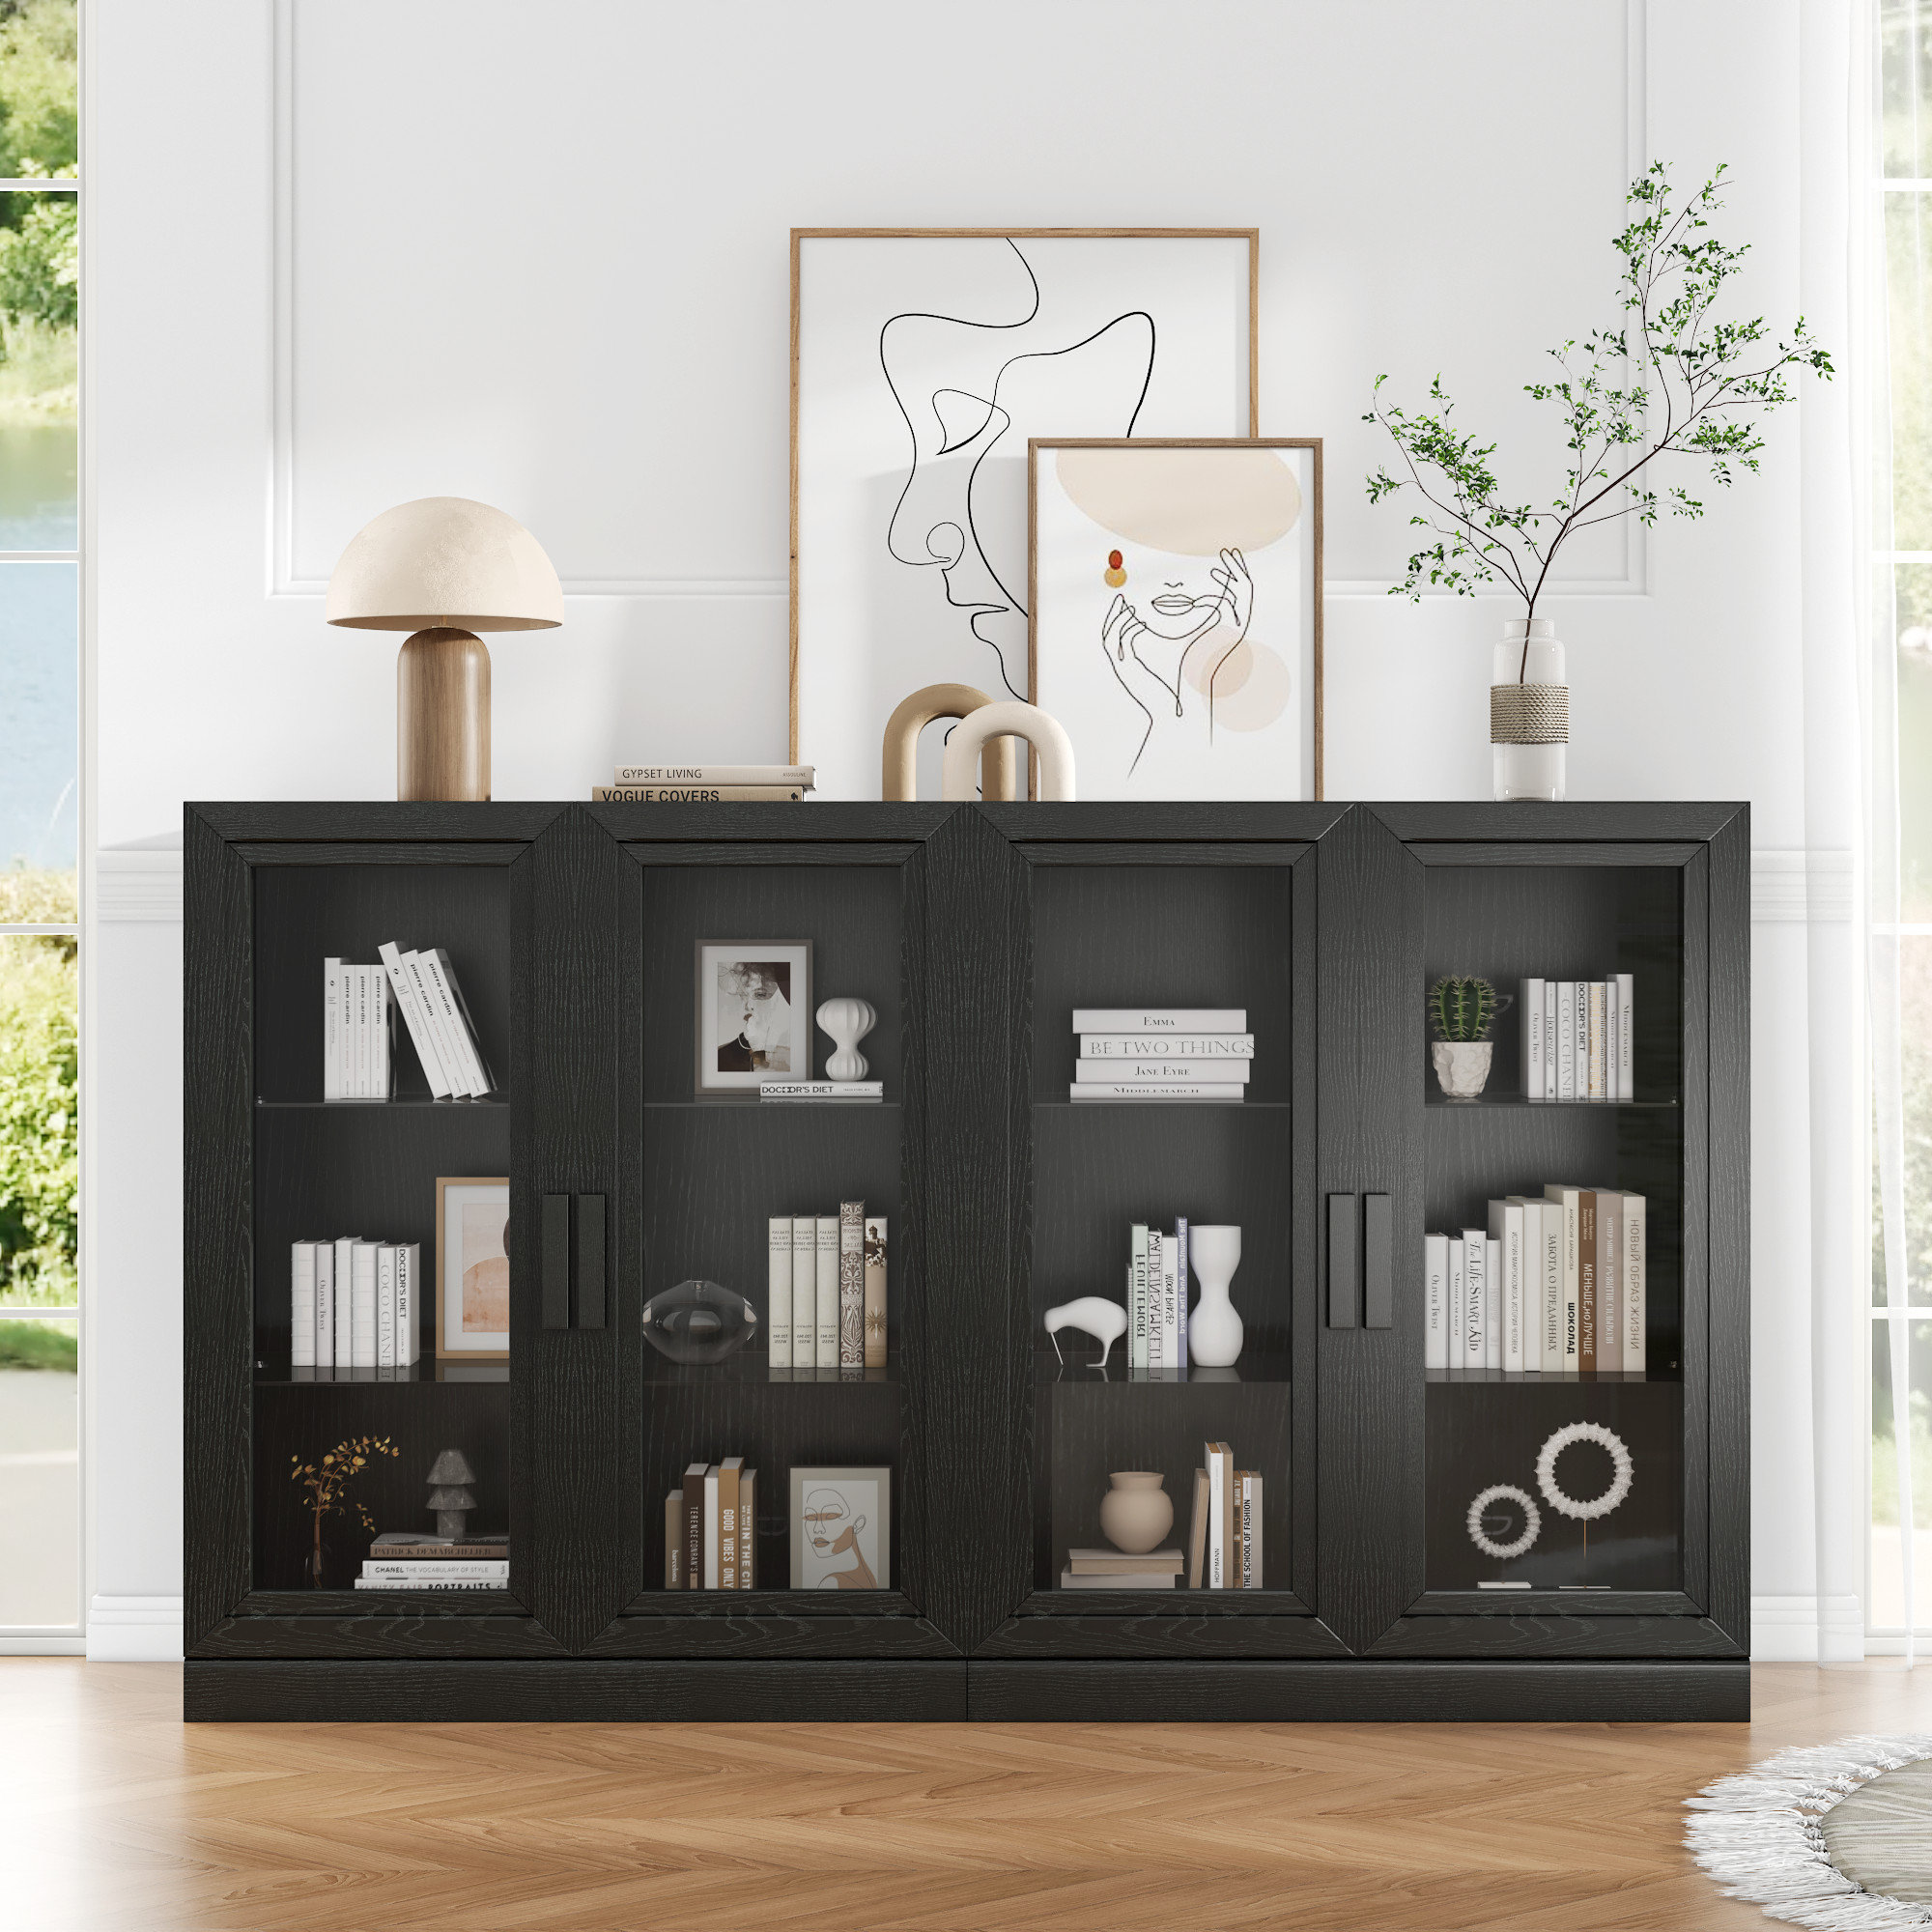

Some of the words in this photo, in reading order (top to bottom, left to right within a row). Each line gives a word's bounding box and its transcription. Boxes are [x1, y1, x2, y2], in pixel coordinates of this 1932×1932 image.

[622, 769, 663, 779] GYPSET
[667, 769, 702, 779] LIVING
[602, 790, 654, 802] VOGUE
[659, 790, 720, 802] COVERS
[410, 963, 423, 988] pierre
[421, 990, 434, 1016] cardin
[428, 963, 441, 987] pierre
[439, 989, 452, 1015] cardin
[1090, 1041, 1112, 1055] BE
[1119, 1041, 1169, 1054] TWO
[1176, 1040, 1254, 1054] THINGS
[1548, 1234, 1557, 1271] ЗАБОТА
[1630, 1219, 1641, 1262] НОВЫЙ
[1630, 1265, 1639, 1302] ОБРАЗ
[1548, 1286, 1557, 1350] ПРЕДАННЫХ
[1566, 1302, 1576, 1354] ШОКОЛАД
[1630, 1306, 1639, 1350] ЖИЗНИ
[1582, 1321, 1593, 1355] ЛУЧШЕ
[690, 1506, 698, 1538] TERENCE
[724, 1509, 734, 1531] GOOD
[742, 1527, 751, 1540] IN
[724, 1537, 734, 1562] VIBES
[1243, 1531, 1251, 1542] OF
[742, 1544, 751, 1567] THE
[724, 1568, 734, 1589] ONLY
